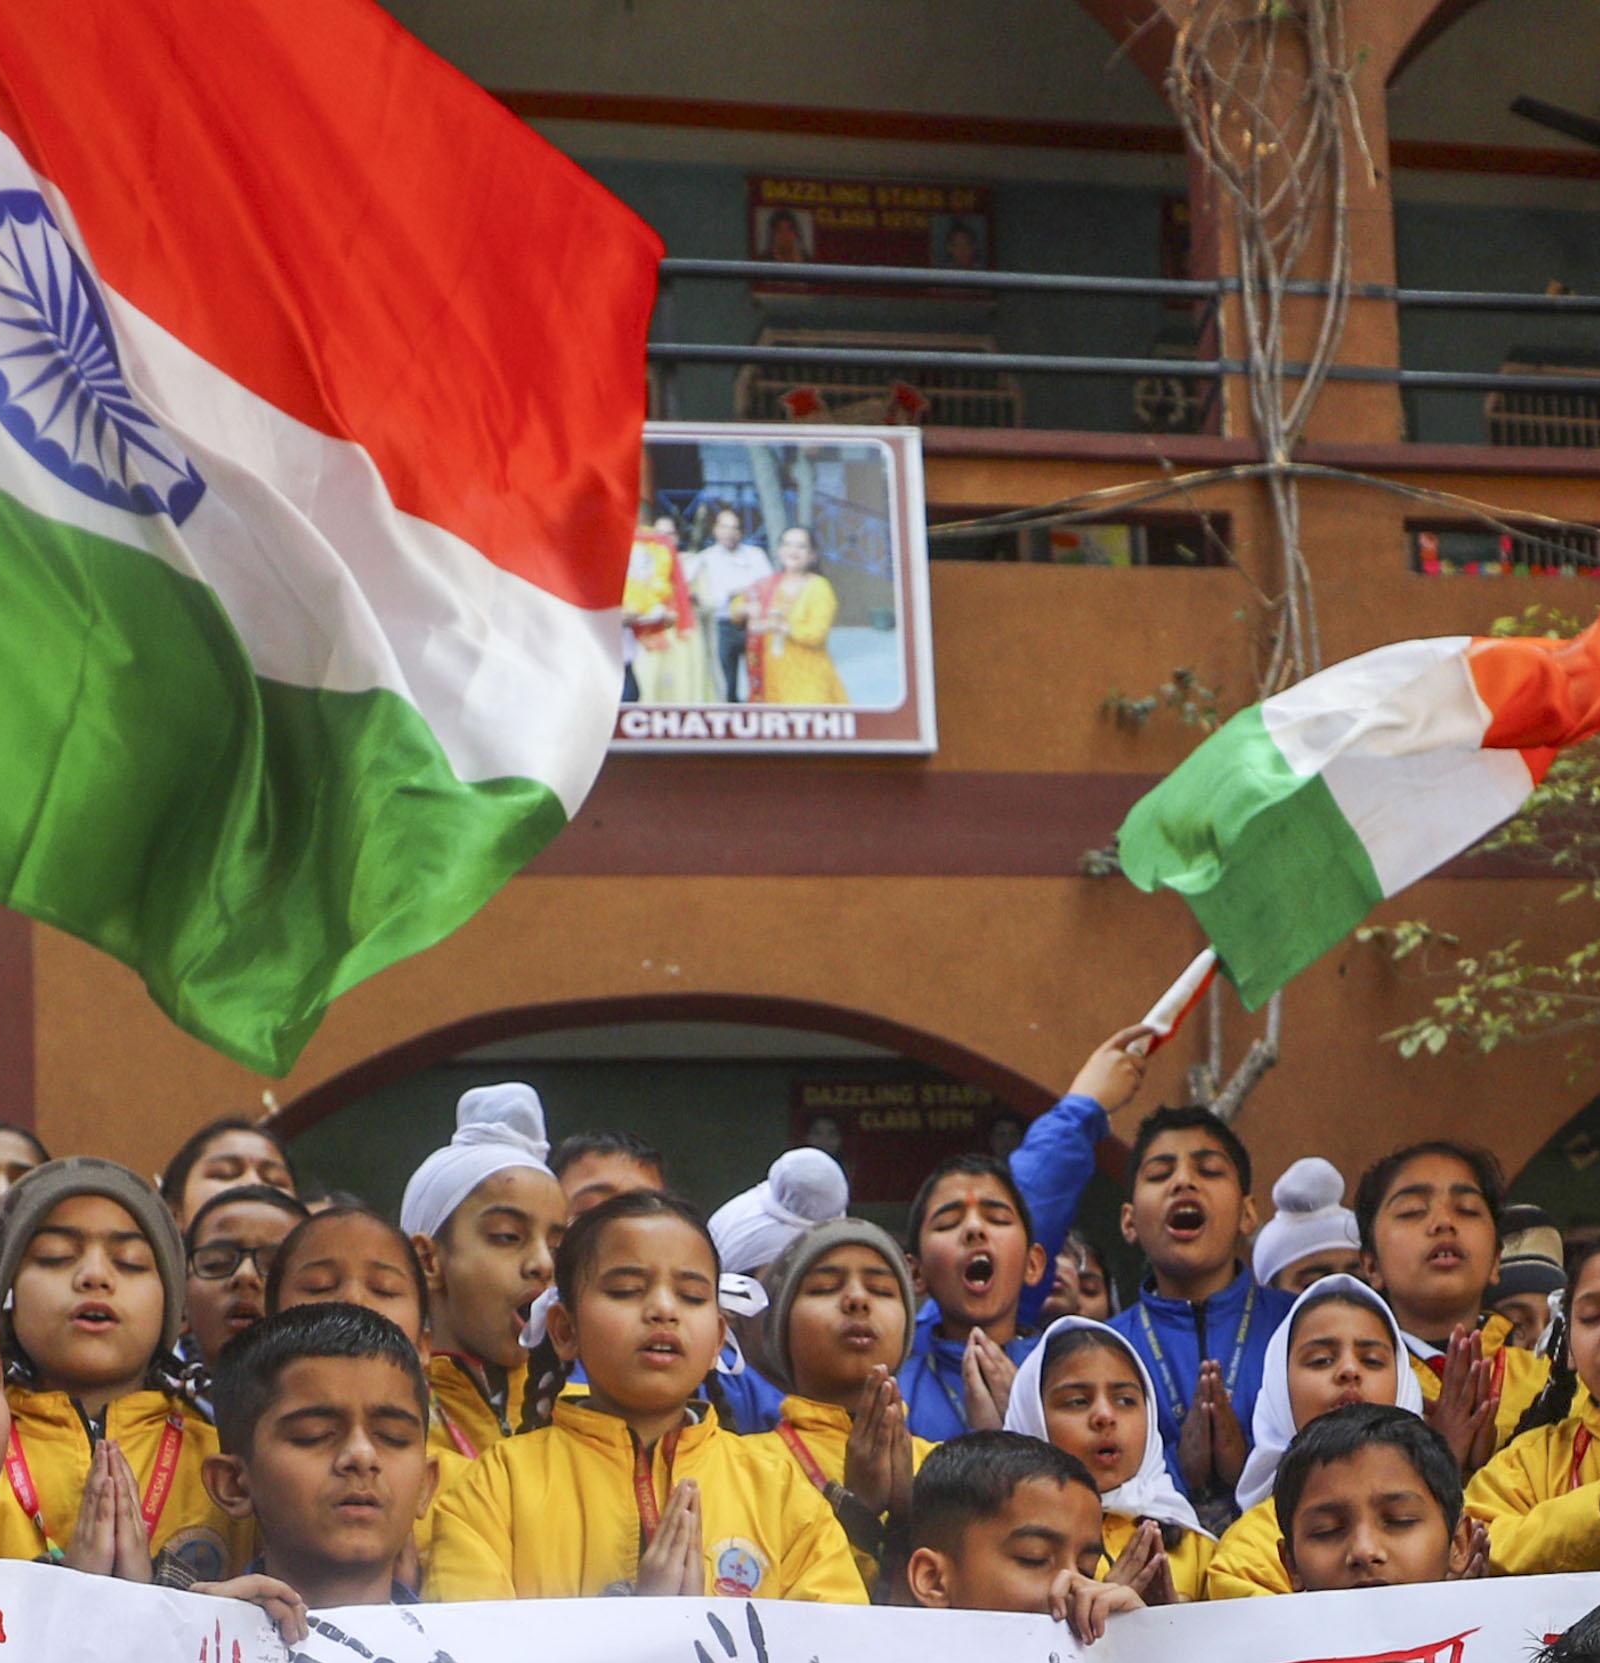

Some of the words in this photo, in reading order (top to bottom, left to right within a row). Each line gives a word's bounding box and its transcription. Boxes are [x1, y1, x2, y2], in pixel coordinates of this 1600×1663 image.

[761, 179, 869, 204] DAZZLING
[875, 186, 945, 207] STARS
[816, 207, 877, 227] CLASS
[620, 709, 856, 740] CHATURTHI
[803, 1085, 915, 1105] DAZZLING
[859, 1110, 922, 1129] CLASS
[928, 1110, 975, 1129] 10TH
